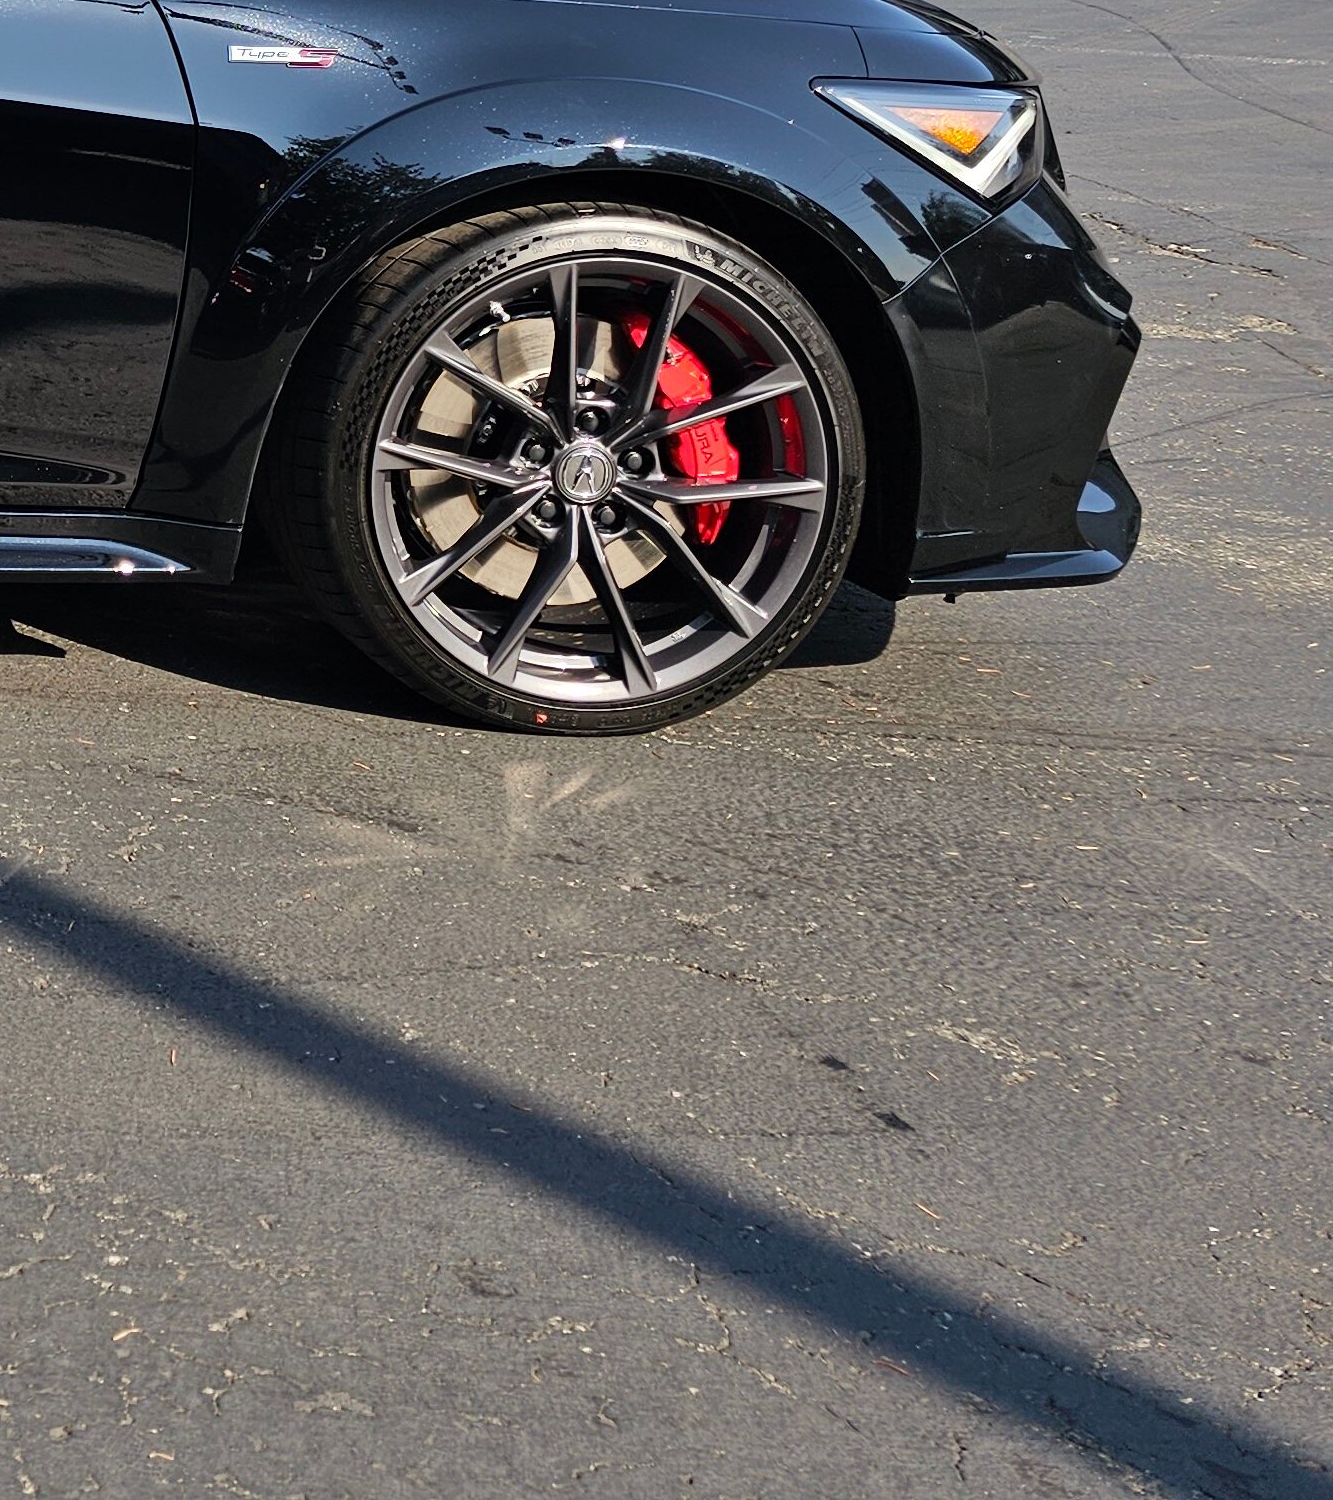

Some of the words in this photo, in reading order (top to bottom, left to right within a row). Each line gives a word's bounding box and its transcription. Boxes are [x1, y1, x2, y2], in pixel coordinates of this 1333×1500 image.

[236, 48, 289, 60] Type
[286, 48, 339, 68] S
[720, 258, 824, 357] MICHELIN
